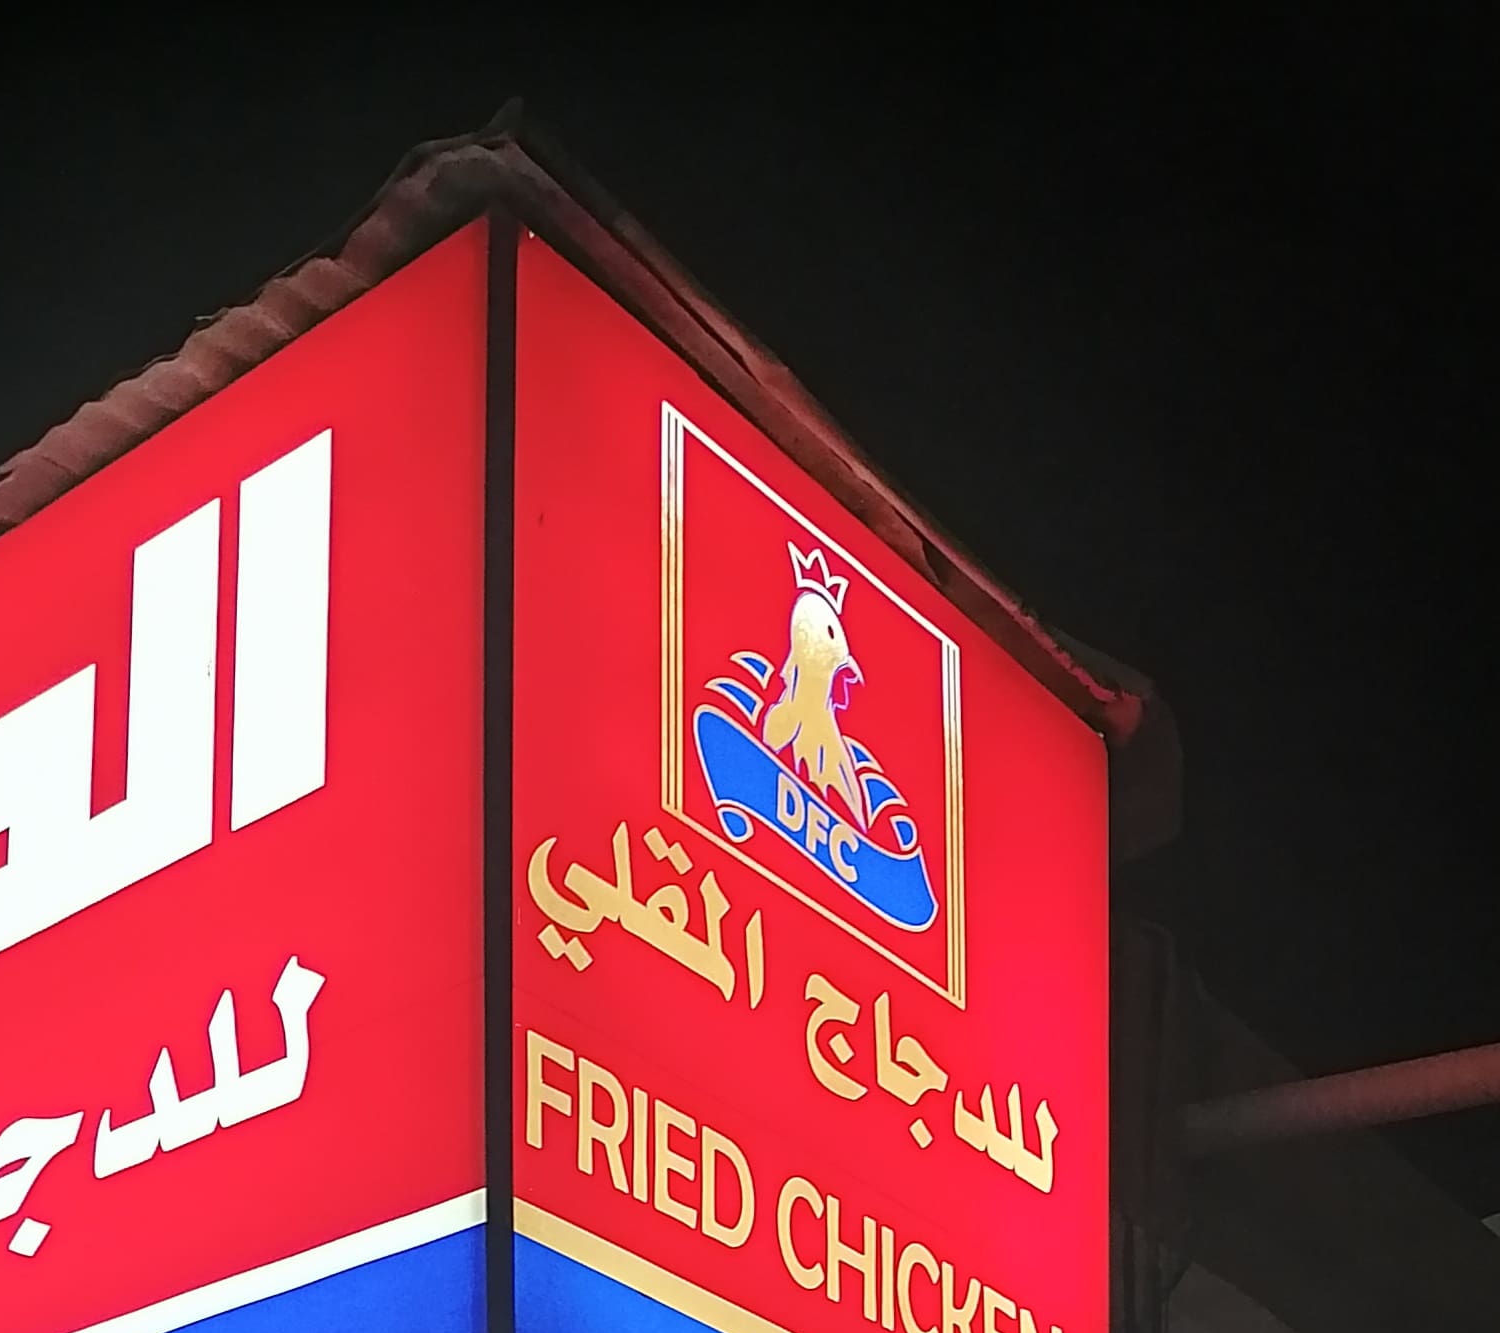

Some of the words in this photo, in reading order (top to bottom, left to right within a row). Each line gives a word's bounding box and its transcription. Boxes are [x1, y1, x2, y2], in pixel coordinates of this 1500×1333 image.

[525, 822, 766, 1010] المقلي
[774, 772, 860, 885] DFC
[525, 1028, 757, 1248] FRIED
[804, 973, 1059, 1195] للدجاج
